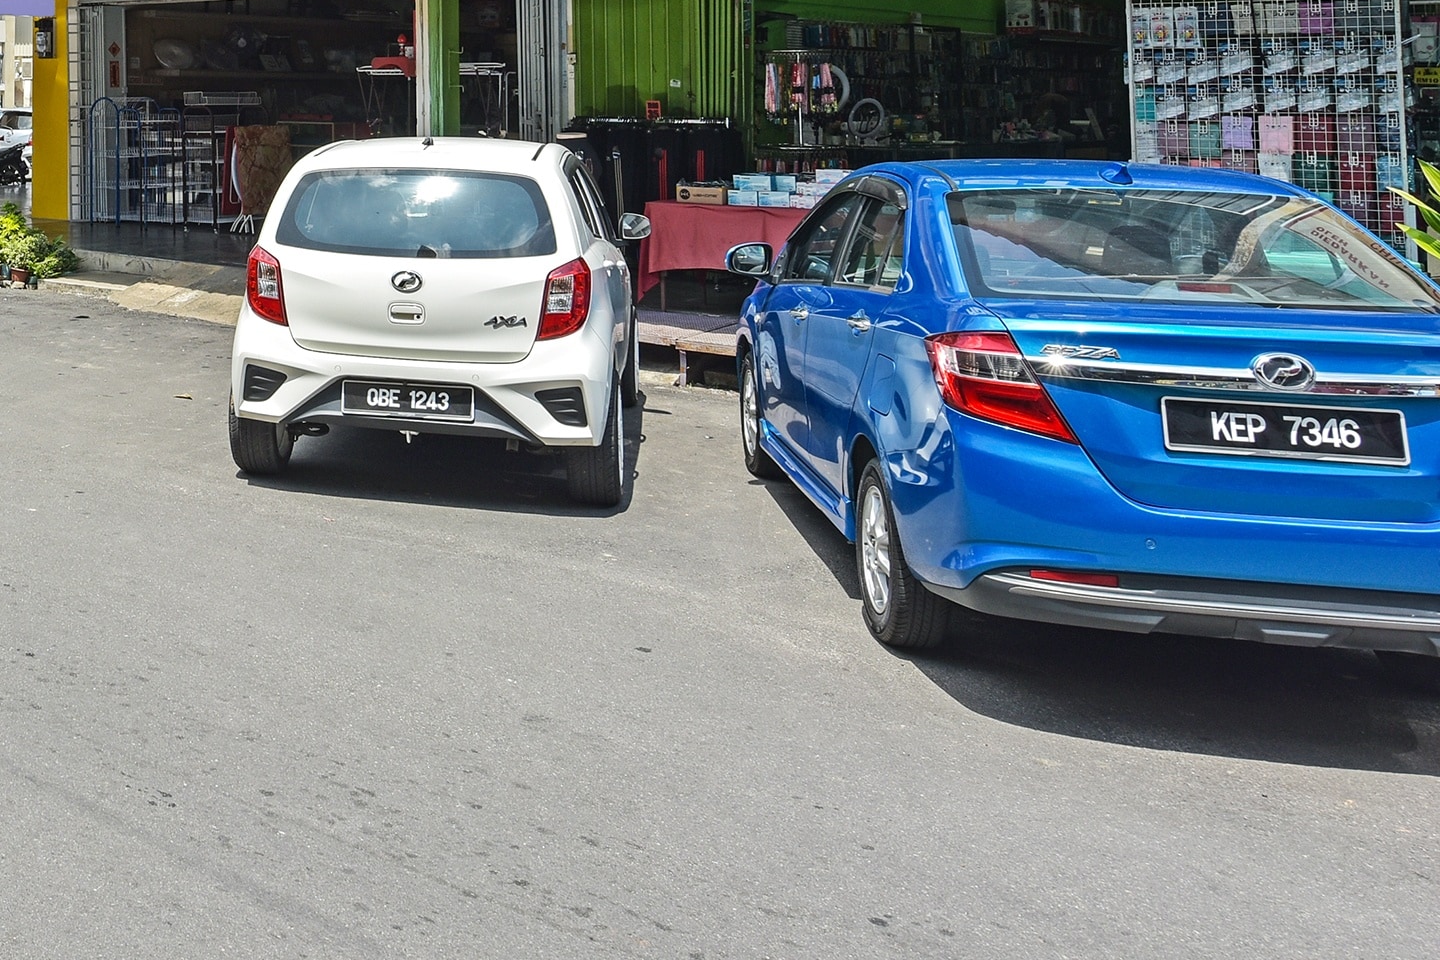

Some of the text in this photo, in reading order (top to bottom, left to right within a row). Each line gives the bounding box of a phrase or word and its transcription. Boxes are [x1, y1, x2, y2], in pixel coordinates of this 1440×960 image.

[366, 388, 450, 411] QBE 1243
[1210, 412, 1361, 449] KEP 7346
